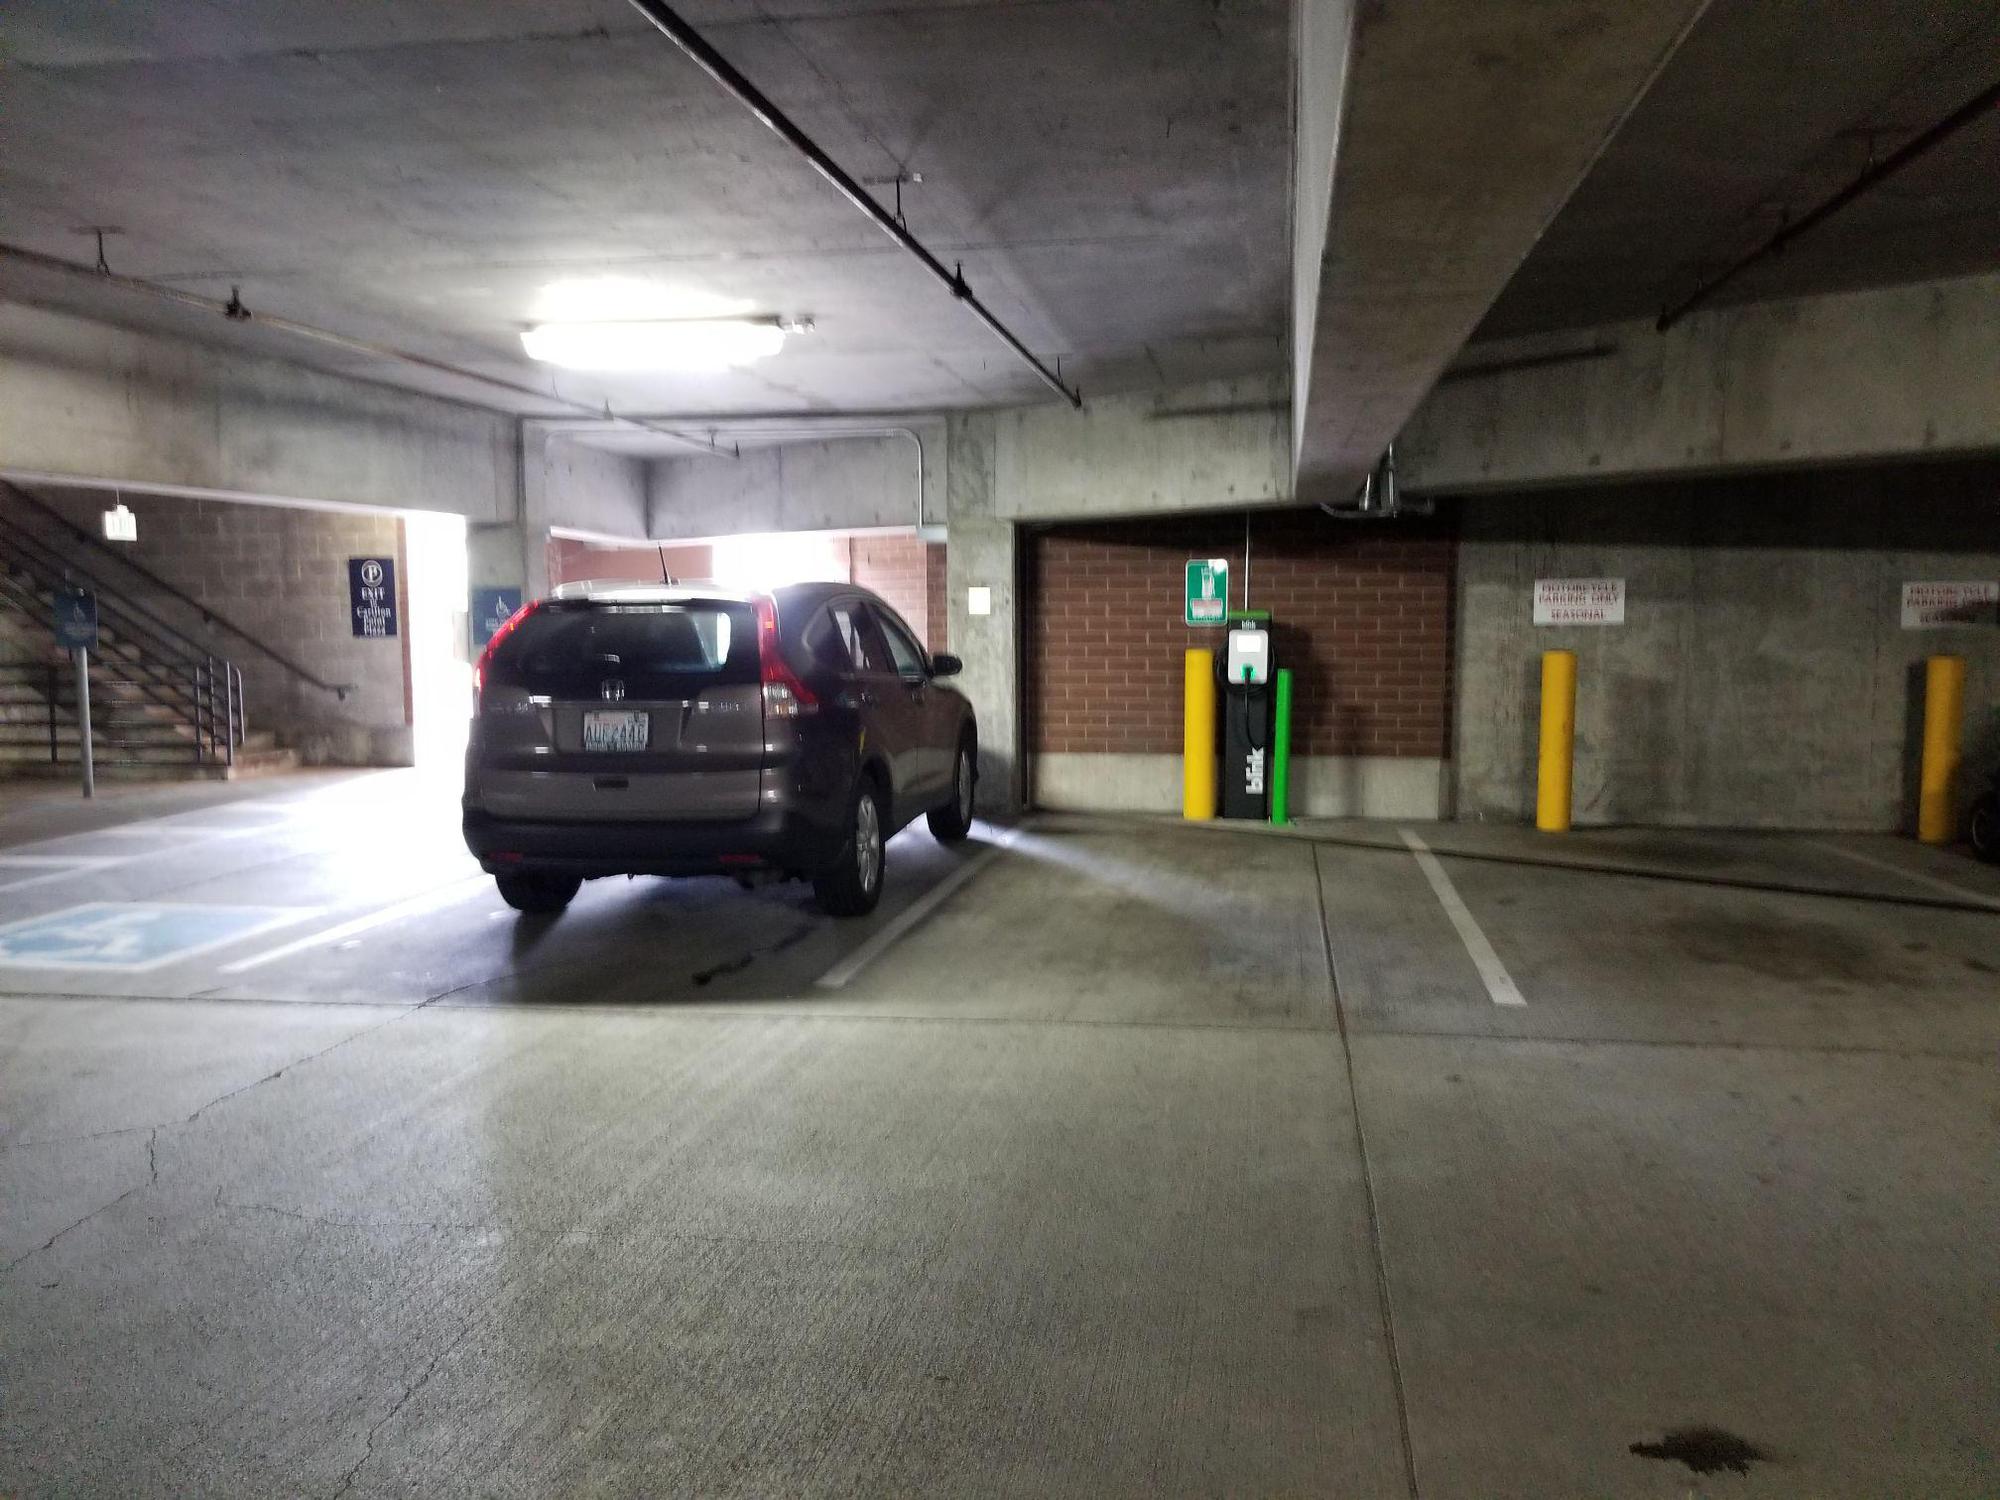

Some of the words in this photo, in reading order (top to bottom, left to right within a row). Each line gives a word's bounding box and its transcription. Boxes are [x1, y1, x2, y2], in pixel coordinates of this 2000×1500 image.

[361, 587, 385, 600] EXIT
[1551, 608, 1604, 620] SEASONAL
[1245, 745, 1264, 795] blink
